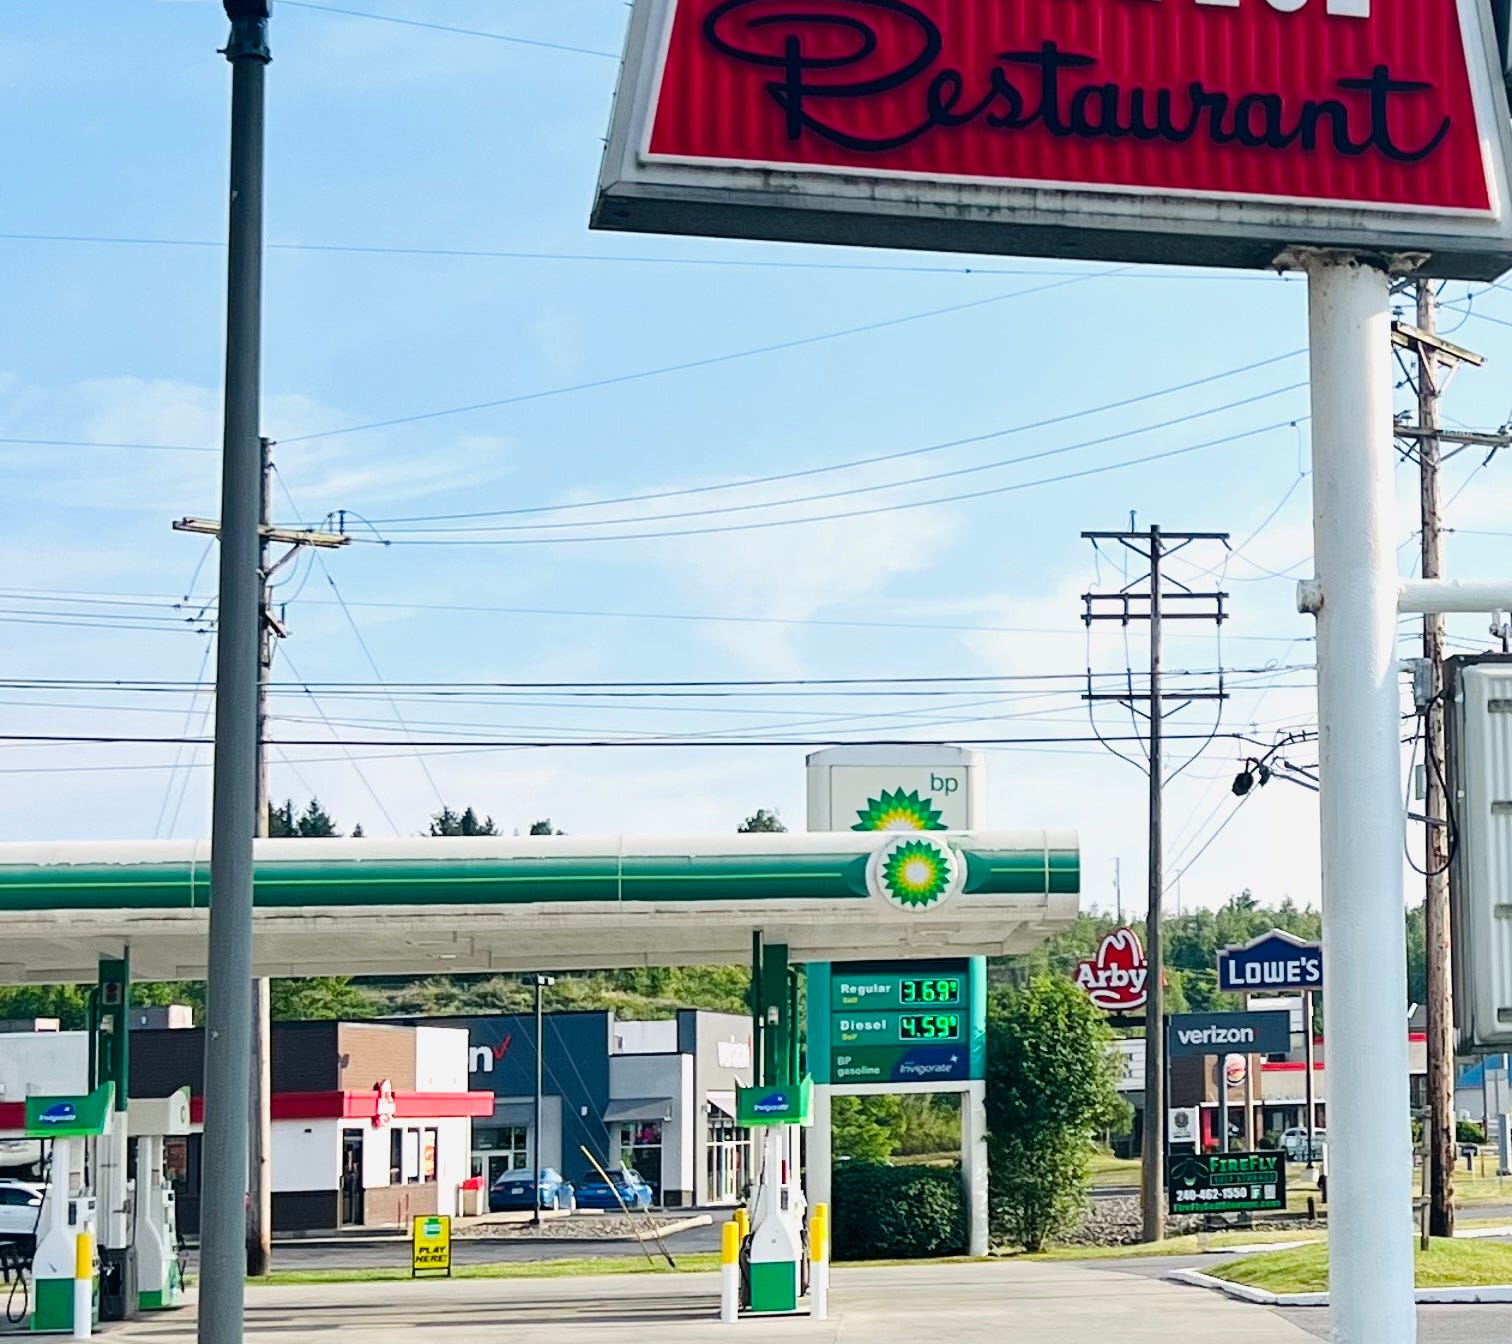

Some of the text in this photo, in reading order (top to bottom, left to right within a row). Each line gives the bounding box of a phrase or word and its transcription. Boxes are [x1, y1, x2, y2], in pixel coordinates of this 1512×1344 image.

[930, 772, 959, 796] bp
[1076, 960, 1148, 992] Arby'
[1229, 957, 1320, 985] LOWE'S
[841, 984, 892, 996] Regular
[840, 1019, 887, 1031] Diesel
[1177, 1025, 1254, 1045] verizon
[837, 1056, 852, 1065] BP
[837, 1066, 880, 1077] gasoline
[419, 1246, 446, 1254] PLAY
